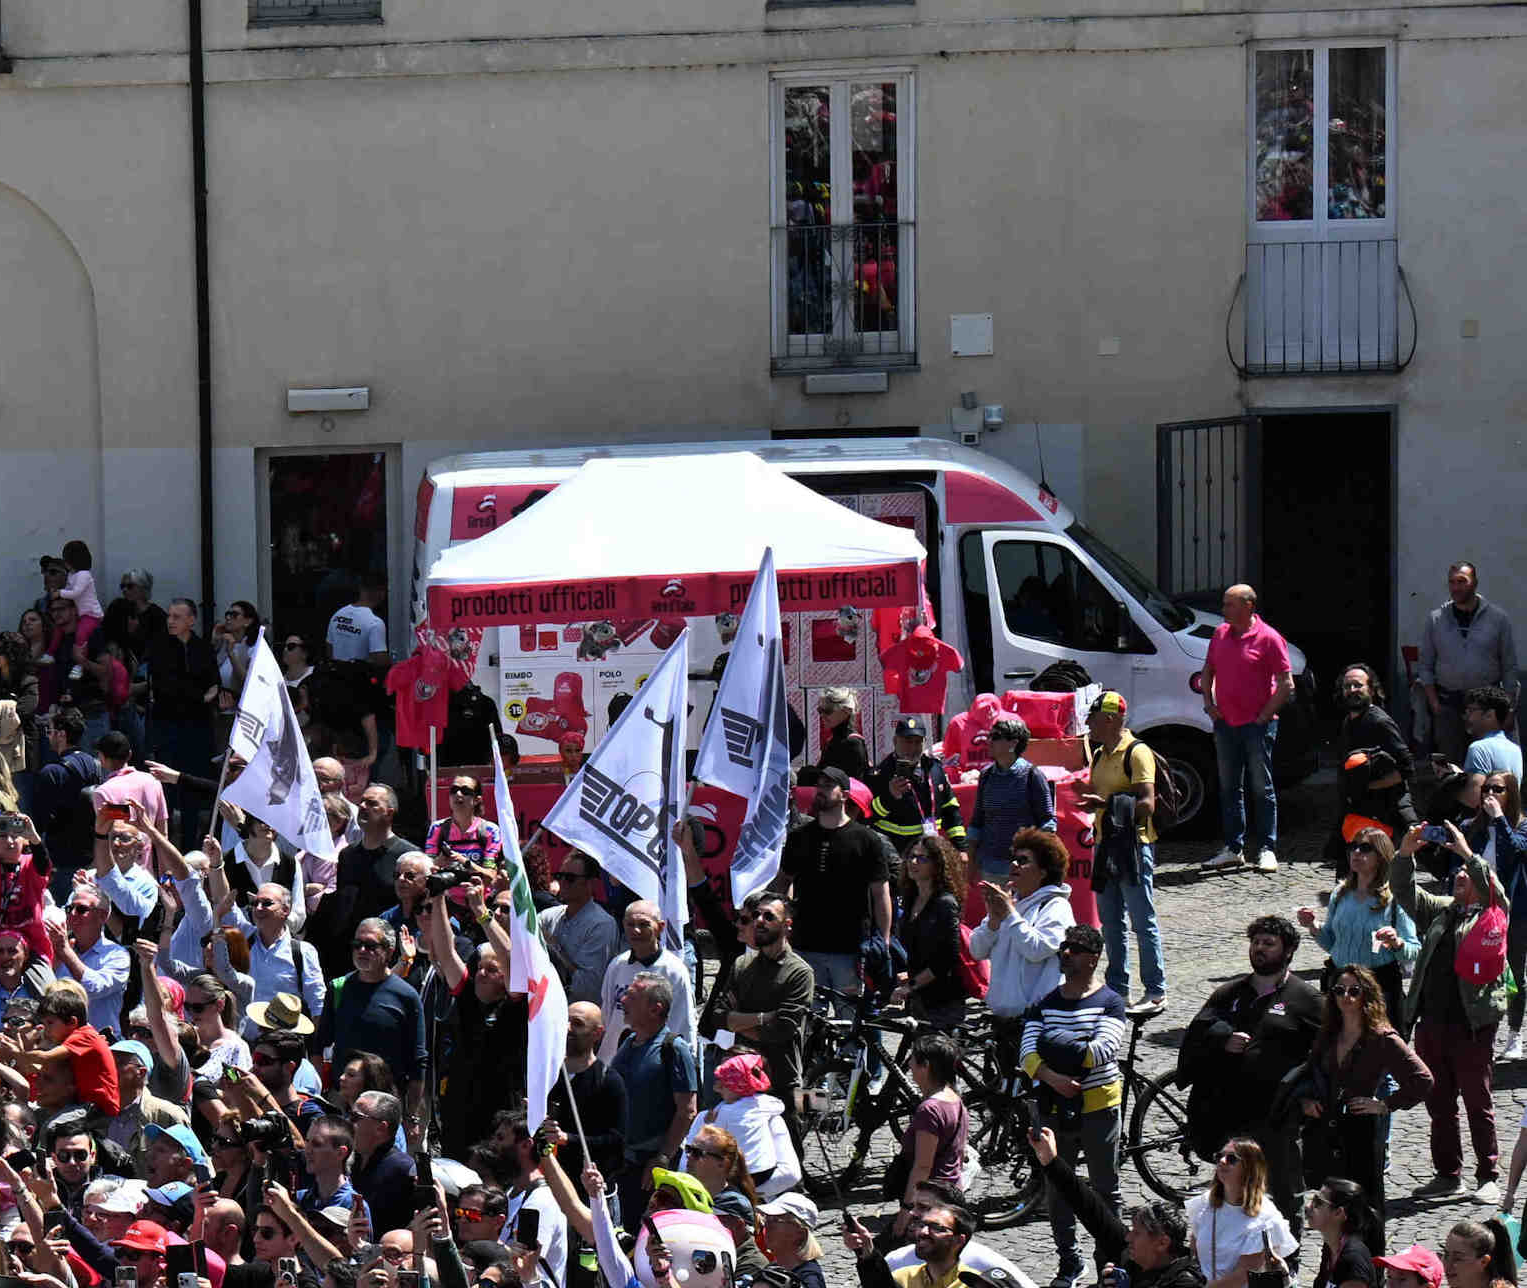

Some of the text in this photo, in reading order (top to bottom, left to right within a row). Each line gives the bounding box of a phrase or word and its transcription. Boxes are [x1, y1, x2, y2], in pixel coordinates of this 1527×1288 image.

[818, 568, 898, 600] ufficiali
[451, 583, 617, 621] prodotti ufficiali
[504, 671, 534, 680] BIMBO
[599, 669, 623, 679] POLO
